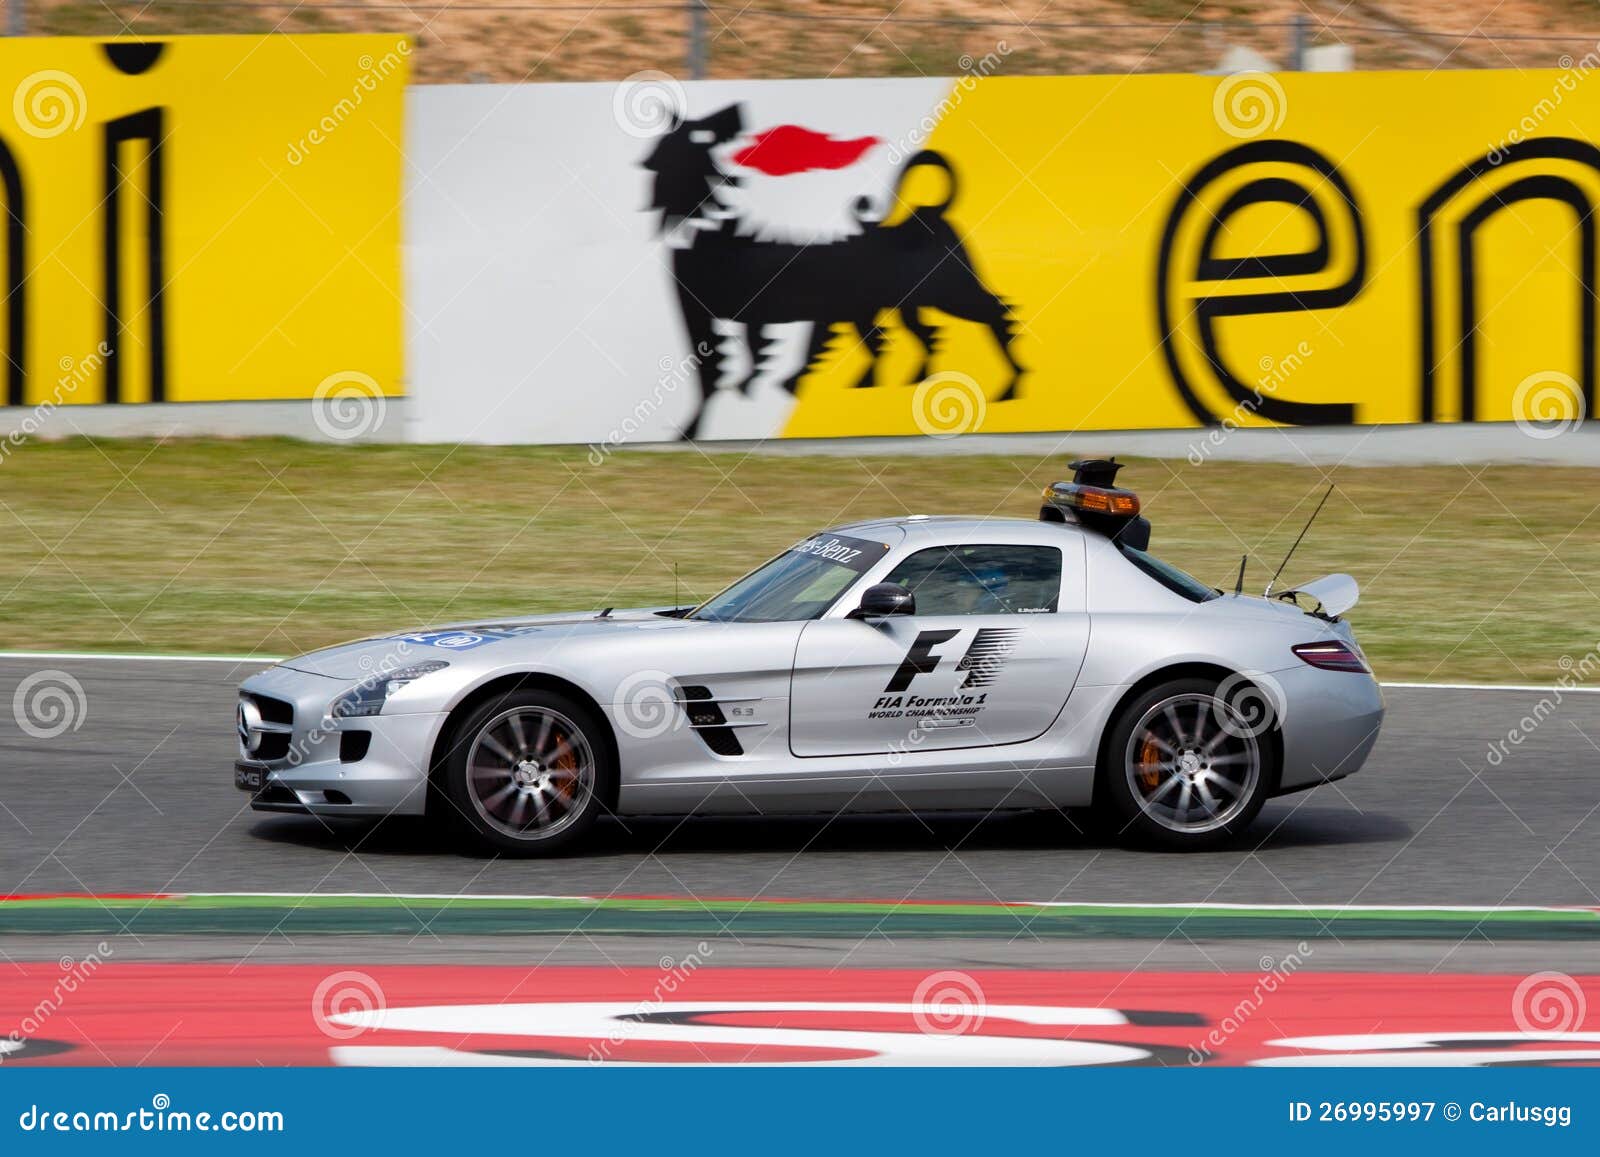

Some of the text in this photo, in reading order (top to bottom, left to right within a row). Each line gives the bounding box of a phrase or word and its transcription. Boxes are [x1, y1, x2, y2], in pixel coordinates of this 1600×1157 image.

[884, 627, 1025, 693] F1
[873, 693, 988, 710] FIA Formula 1
[868, 709, 903, 719] WORLD
